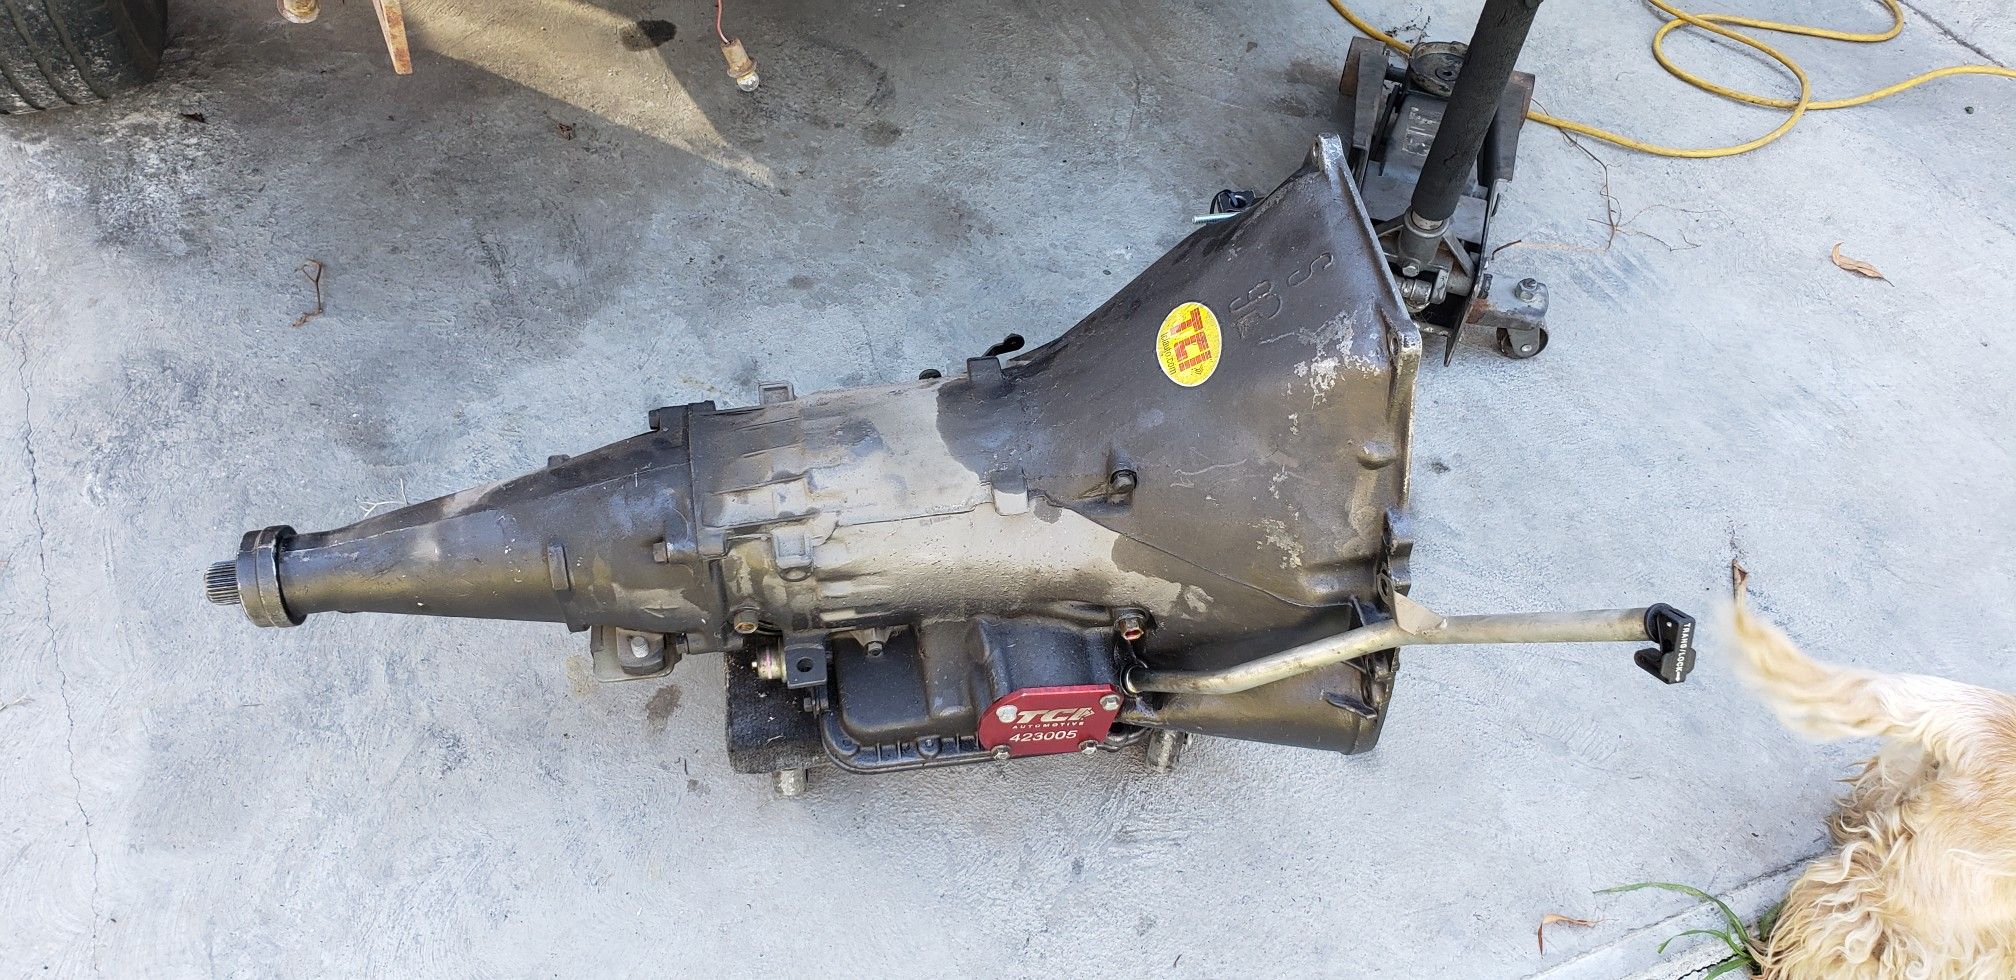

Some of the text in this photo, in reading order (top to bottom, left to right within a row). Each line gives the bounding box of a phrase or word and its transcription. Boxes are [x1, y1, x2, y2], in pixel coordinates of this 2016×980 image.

[1171, 307, 1211, 372] TCI
[1017, 708, 1094, 723] TCI
[1012, 721, 1085, 729] AUTOMOTIVE
[1010, 730, 1077, 742] 423005
